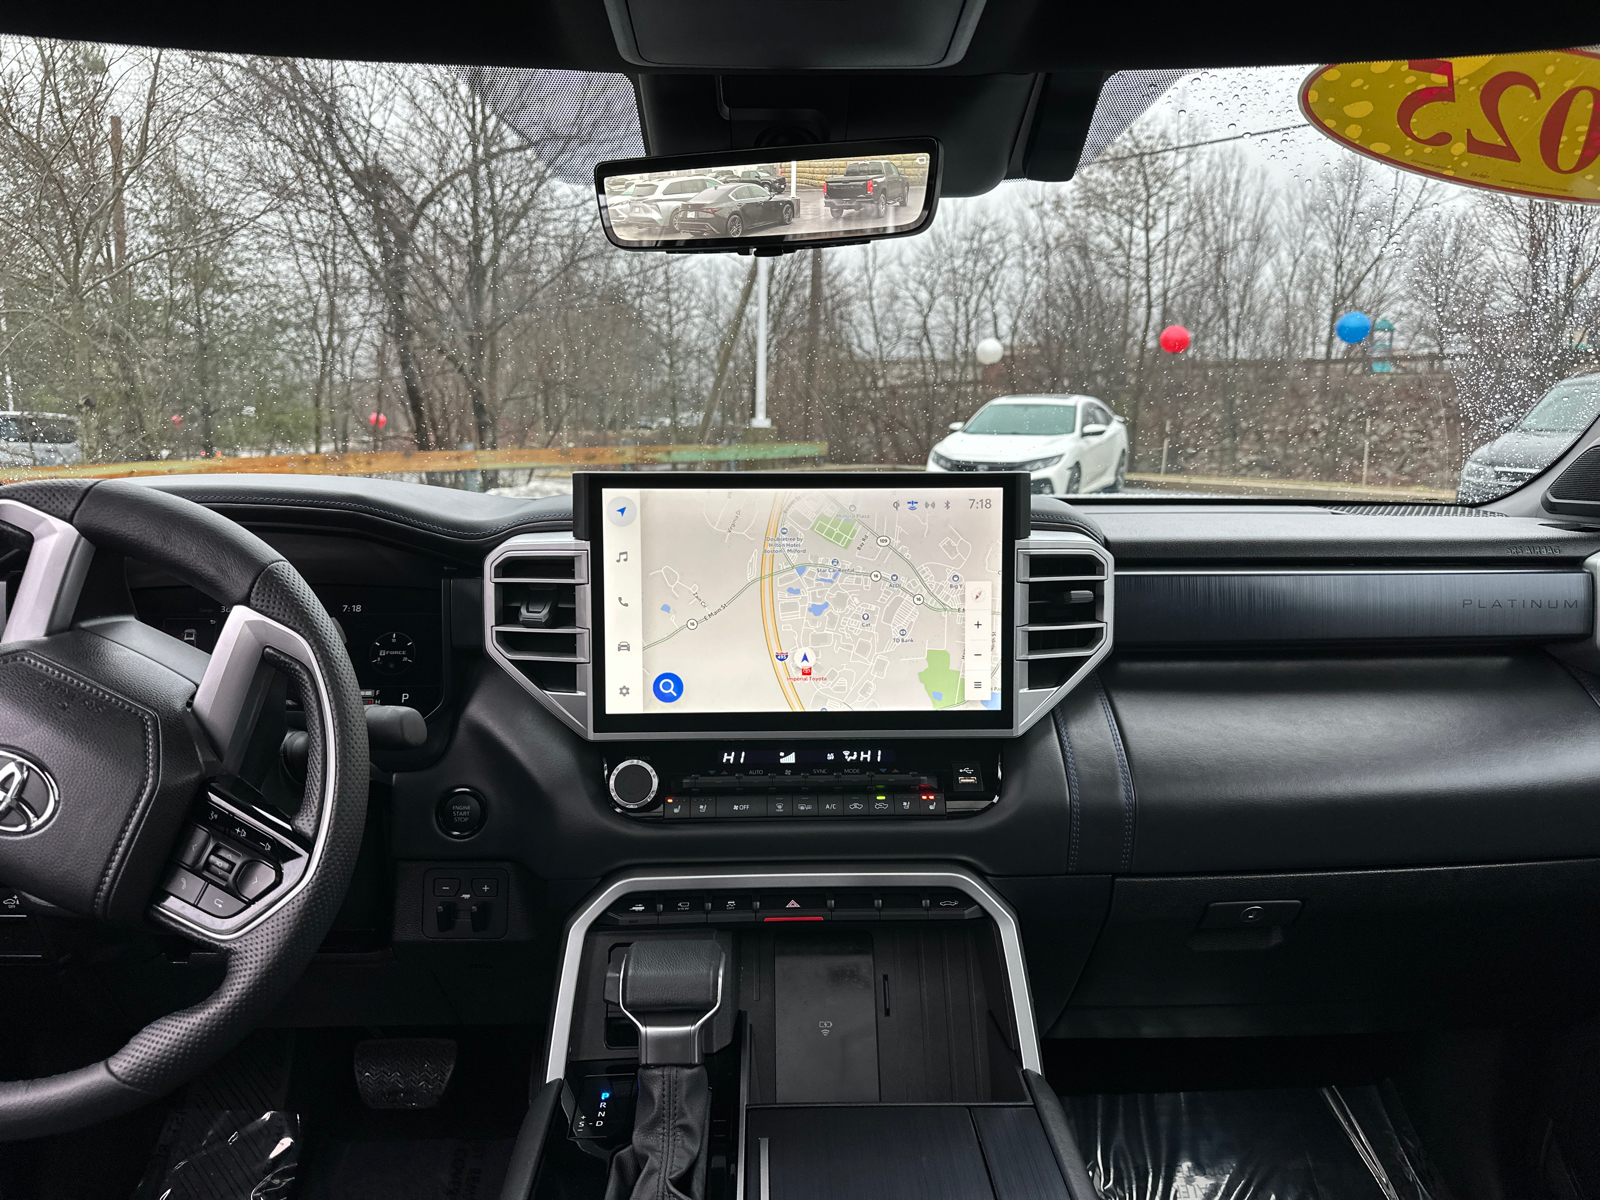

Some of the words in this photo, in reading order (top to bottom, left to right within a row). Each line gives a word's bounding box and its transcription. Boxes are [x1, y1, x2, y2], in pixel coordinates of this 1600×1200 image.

[968, 498, 992, 509] 7:18
[1525, 545, 1561, 555] AIRBAG
[342, 604, 362, 613] 7:18
[1462, 599, 1578, 609] PLATINUM
[708, 608, 722, 620] Main
[720, 603, 728, 611] St
[401, 693, 410, 704] P
[601, 1092, 610, 1100] P
